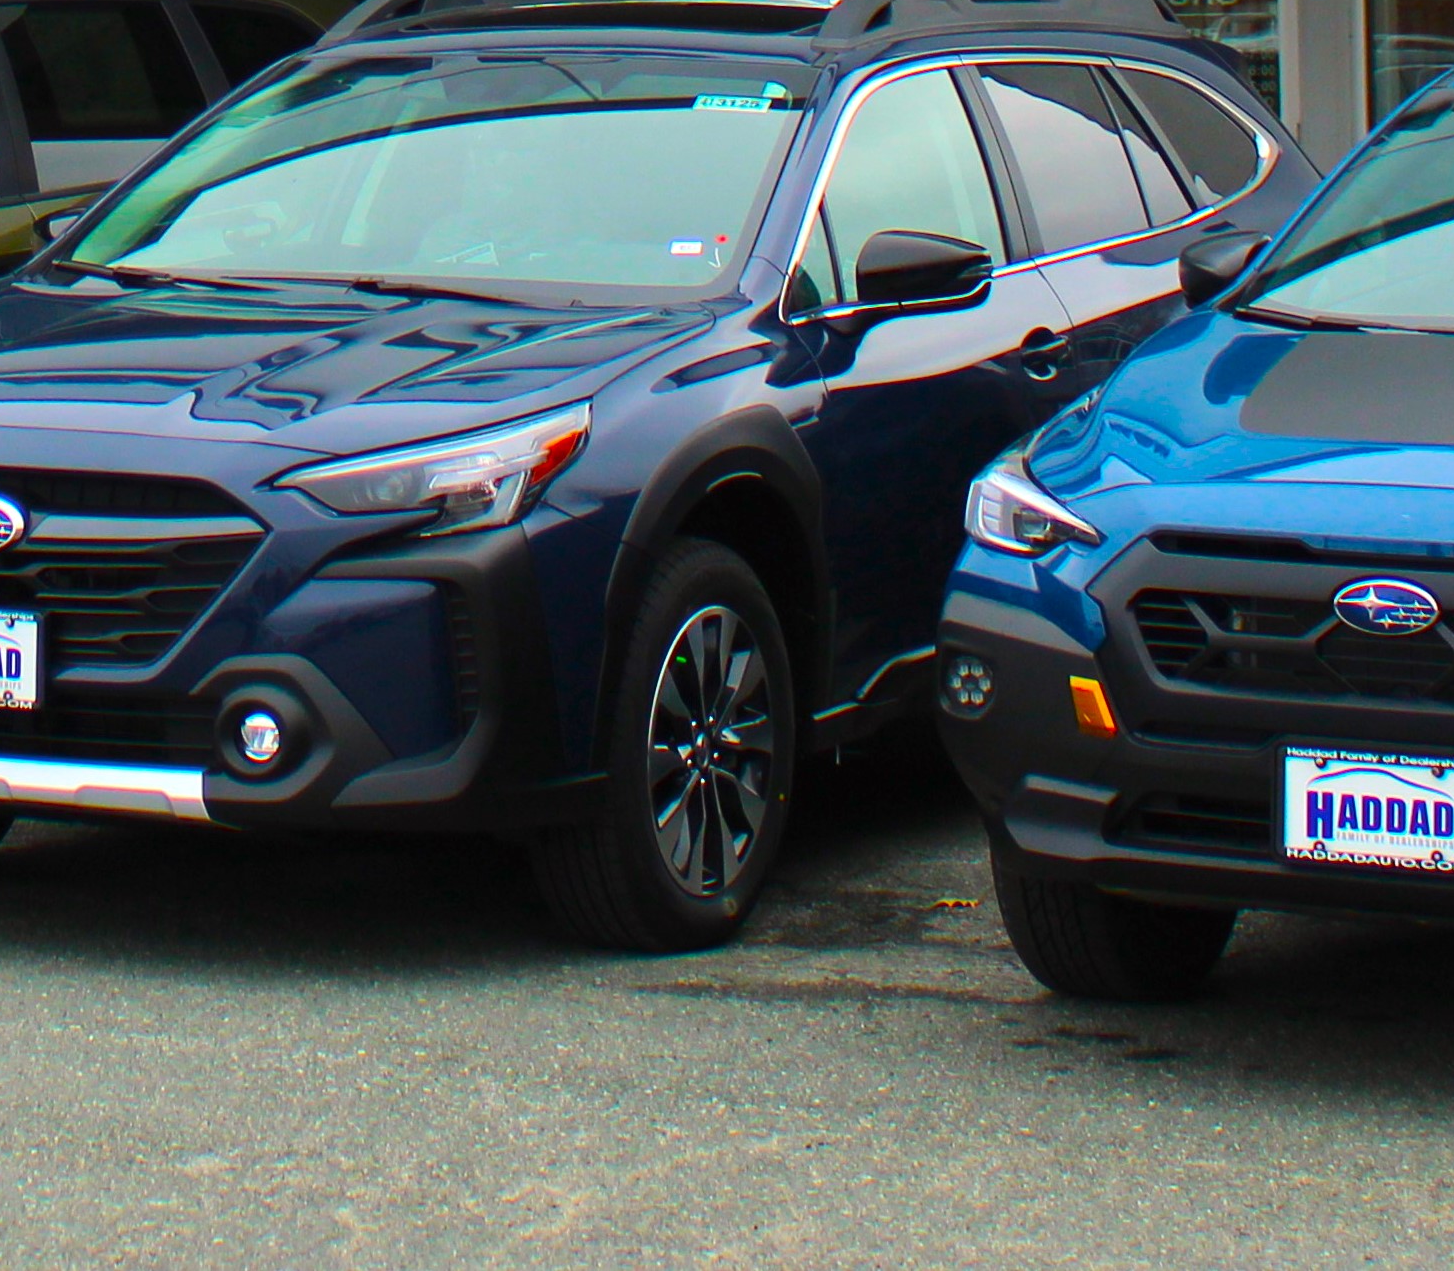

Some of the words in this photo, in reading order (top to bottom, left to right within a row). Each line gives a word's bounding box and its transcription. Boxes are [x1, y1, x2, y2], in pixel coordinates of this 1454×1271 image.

[1286, 747, 1338, 759] Haddad
[1340, 751, 1380, 763] Family
[1383, 753, 1398, 763] of
[1306, 790, 1454, 839] HADDAD
